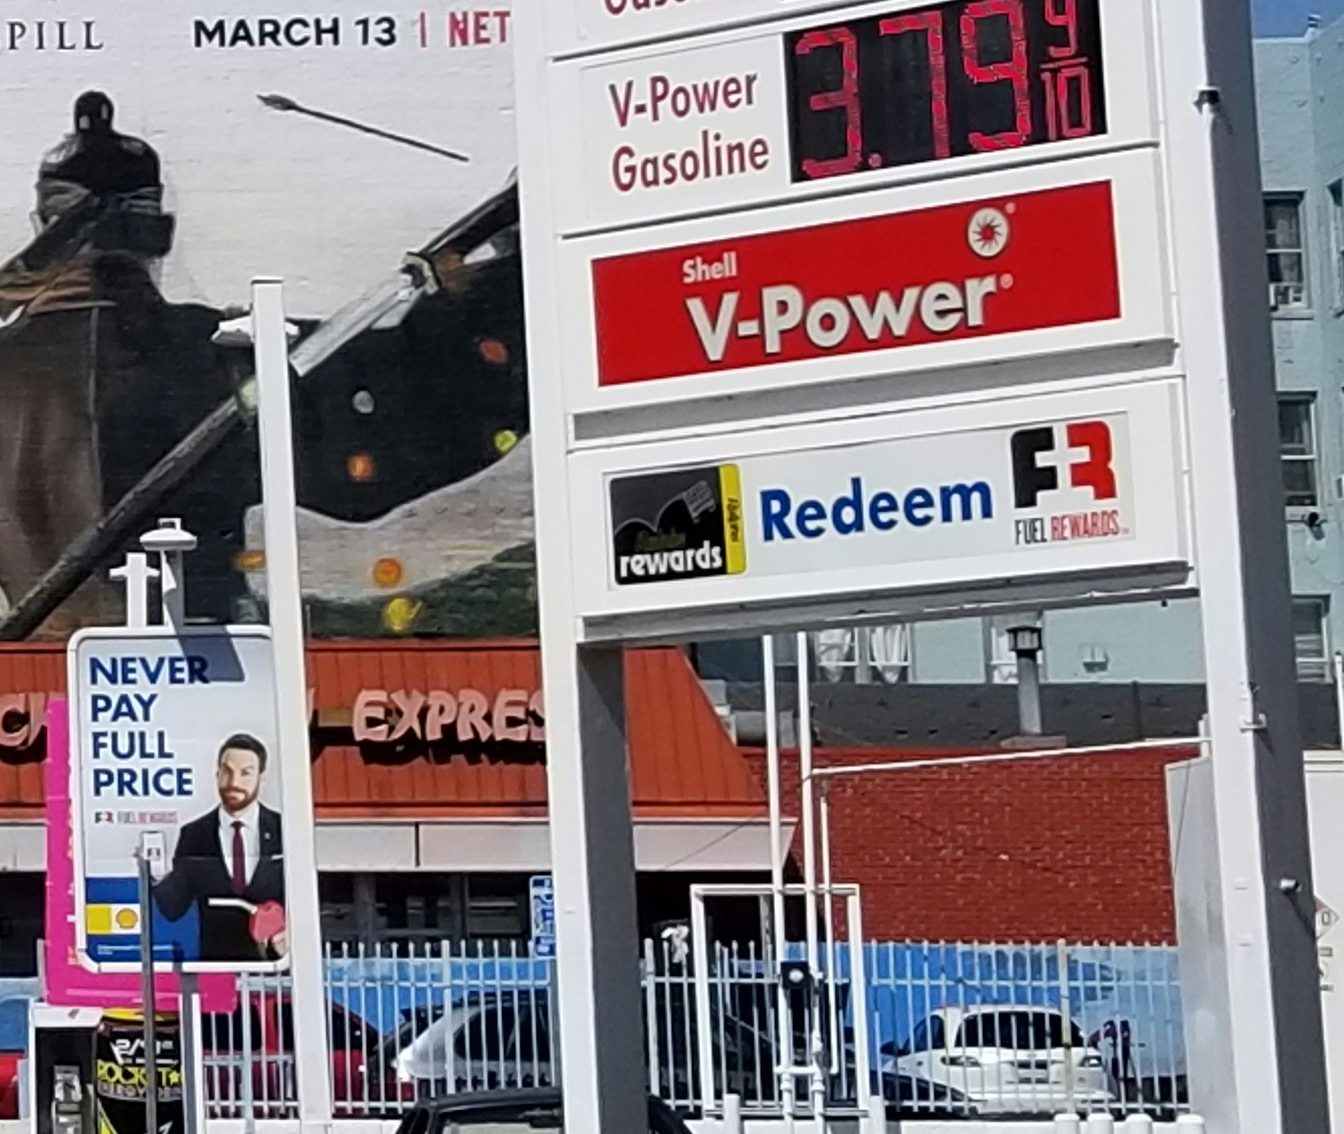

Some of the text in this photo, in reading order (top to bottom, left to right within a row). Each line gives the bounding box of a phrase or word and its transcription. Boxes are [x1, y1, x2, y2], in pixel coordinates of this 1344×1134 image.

[193, 10, 511, 49] MARCH 13 NET
[608, 71, 760, 129] V-Power
[611, 128, 770, 193] Gasoline
[682, 250, 738, 285] Shell
[759, 476, 995, 544] Redeem
[1014, 509, 1120, 545] FUEL REWARDS
[620, 539, 723, 578] rewards
[88, 654, 210, 686] NEVER
[90, 692, 159, 723] PAY
[91, 729, 175, 760] FULL
[92, 767, 194, 797] PRICE
